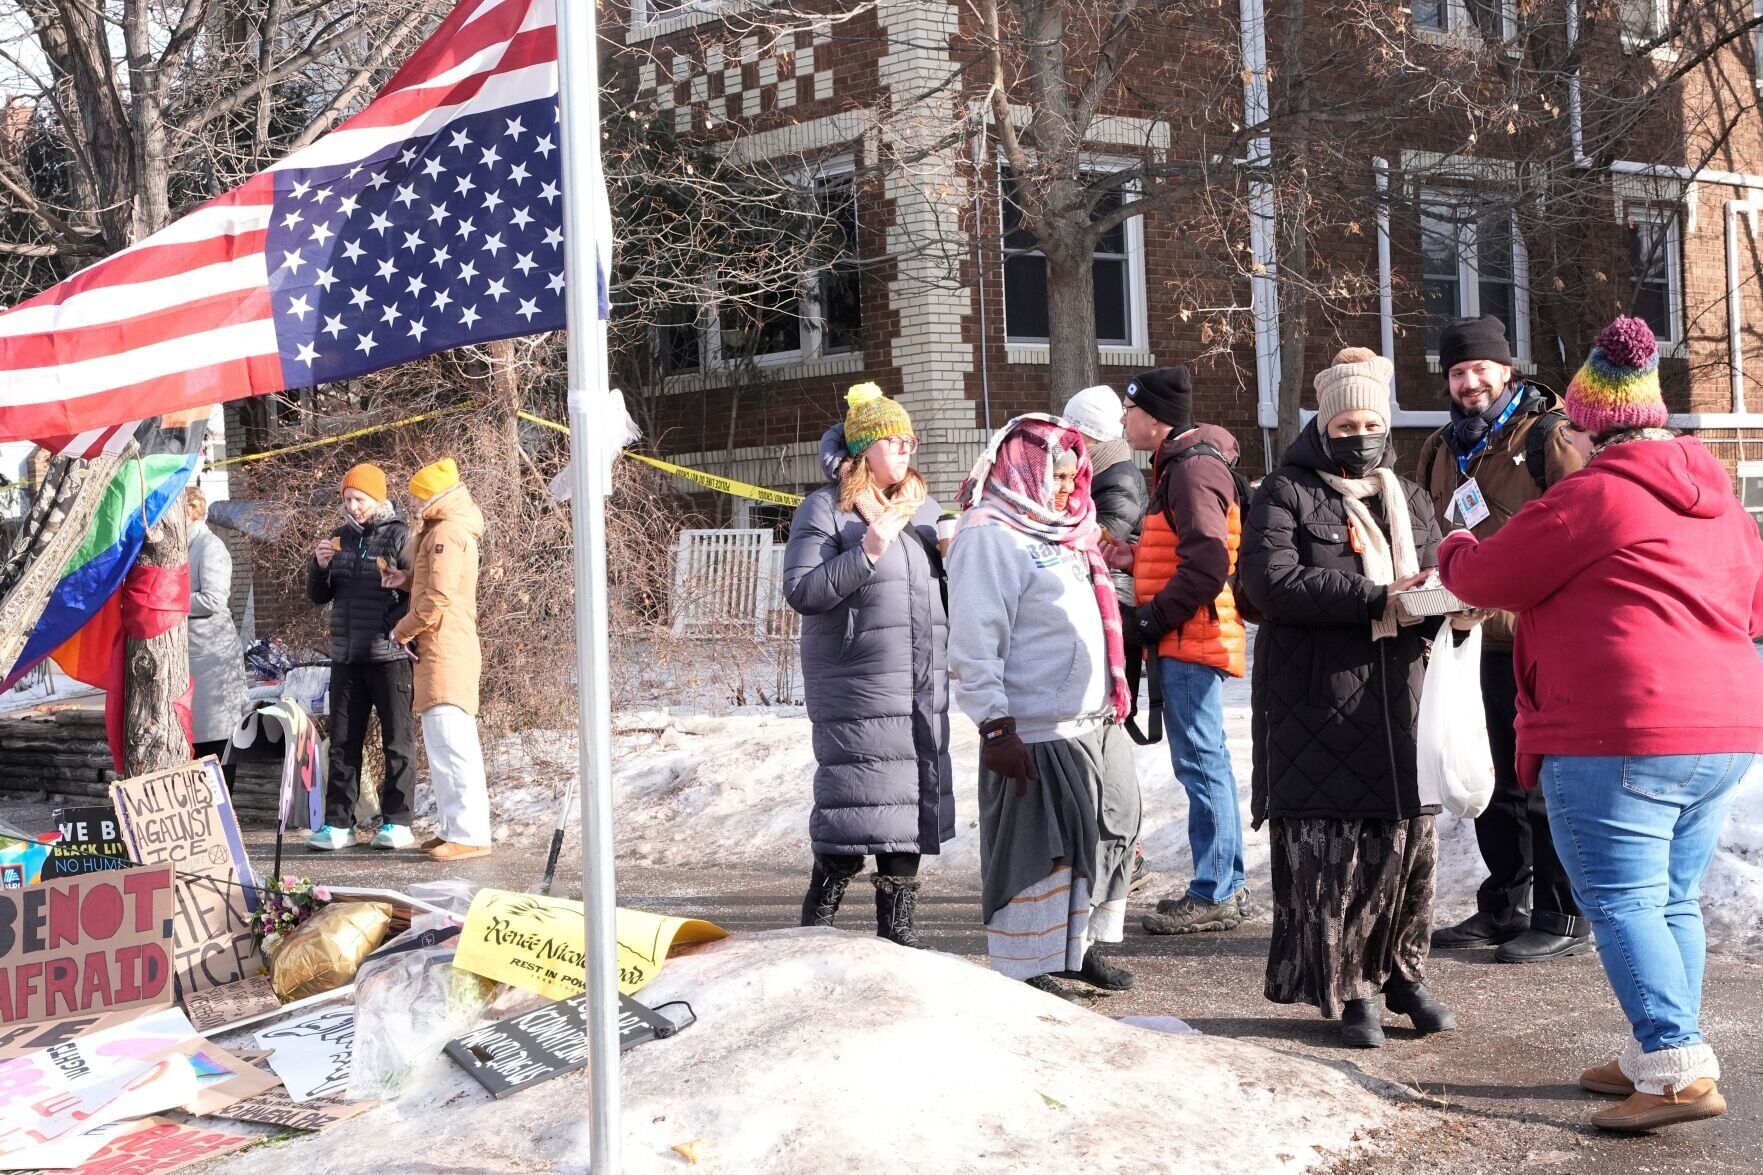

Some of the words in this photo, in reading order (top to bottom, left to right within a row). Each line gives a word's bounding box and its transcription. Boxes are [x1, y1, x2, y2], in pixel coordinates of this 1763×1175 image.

[123, 769, 212, 817] WITCHES
[135, 803, 213, 849] AGAINST
[54, 843, 97, 857] BLACK
[55, 858, 79, 872] NO
[146, 839, 208, 864] ICE
[0, 888, 46, 958] BE
[484, 916, 541, 951] Renée
[0, 942, 169, 1022] AFRAID
[509, 958, 544, 973] REST
[544, 969, 558, 980] IN
[560, 974, 587, 990] POW
